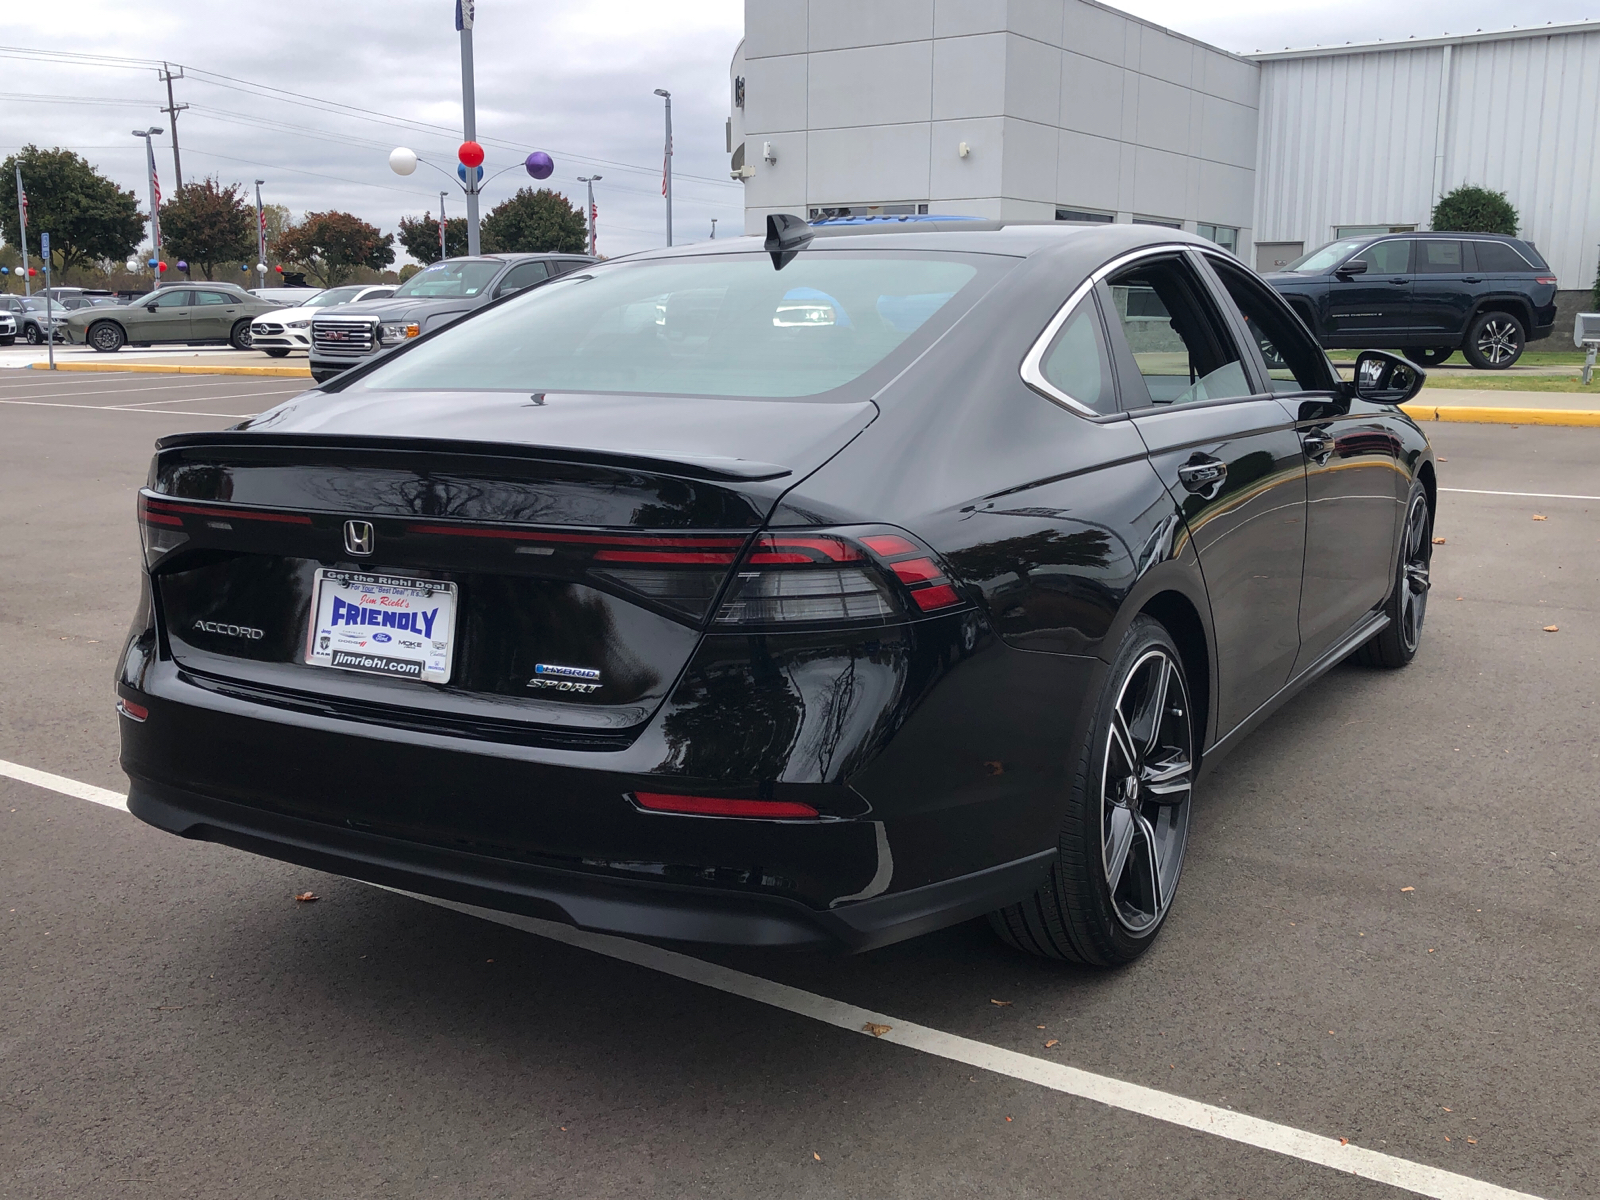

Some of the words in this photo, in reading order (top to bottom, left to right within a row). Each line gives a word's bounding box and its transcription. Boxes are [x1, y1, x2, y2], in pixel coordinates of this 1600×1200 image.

[327, 571, 350, 580] Get
[353, 574, 375, 582] the
[379, 577, 412, 586] Riehl
[416, 581, 445, 590] Deal
[376, 586, 391, 594] "Best
[359, 594, 377, 605] Jim
[380, 596, 410, 608] Riehl's
[331, 595, 439, 640] FRIENDLY
[192, 620, 265, 640] ACCORD
[398, 640, 422, 648] MOKE
[333, 652, 420, 674] jimriehl.com
[544, 666, 596, 678] HYBRID
[526, 678, 603, 694] SPORT
